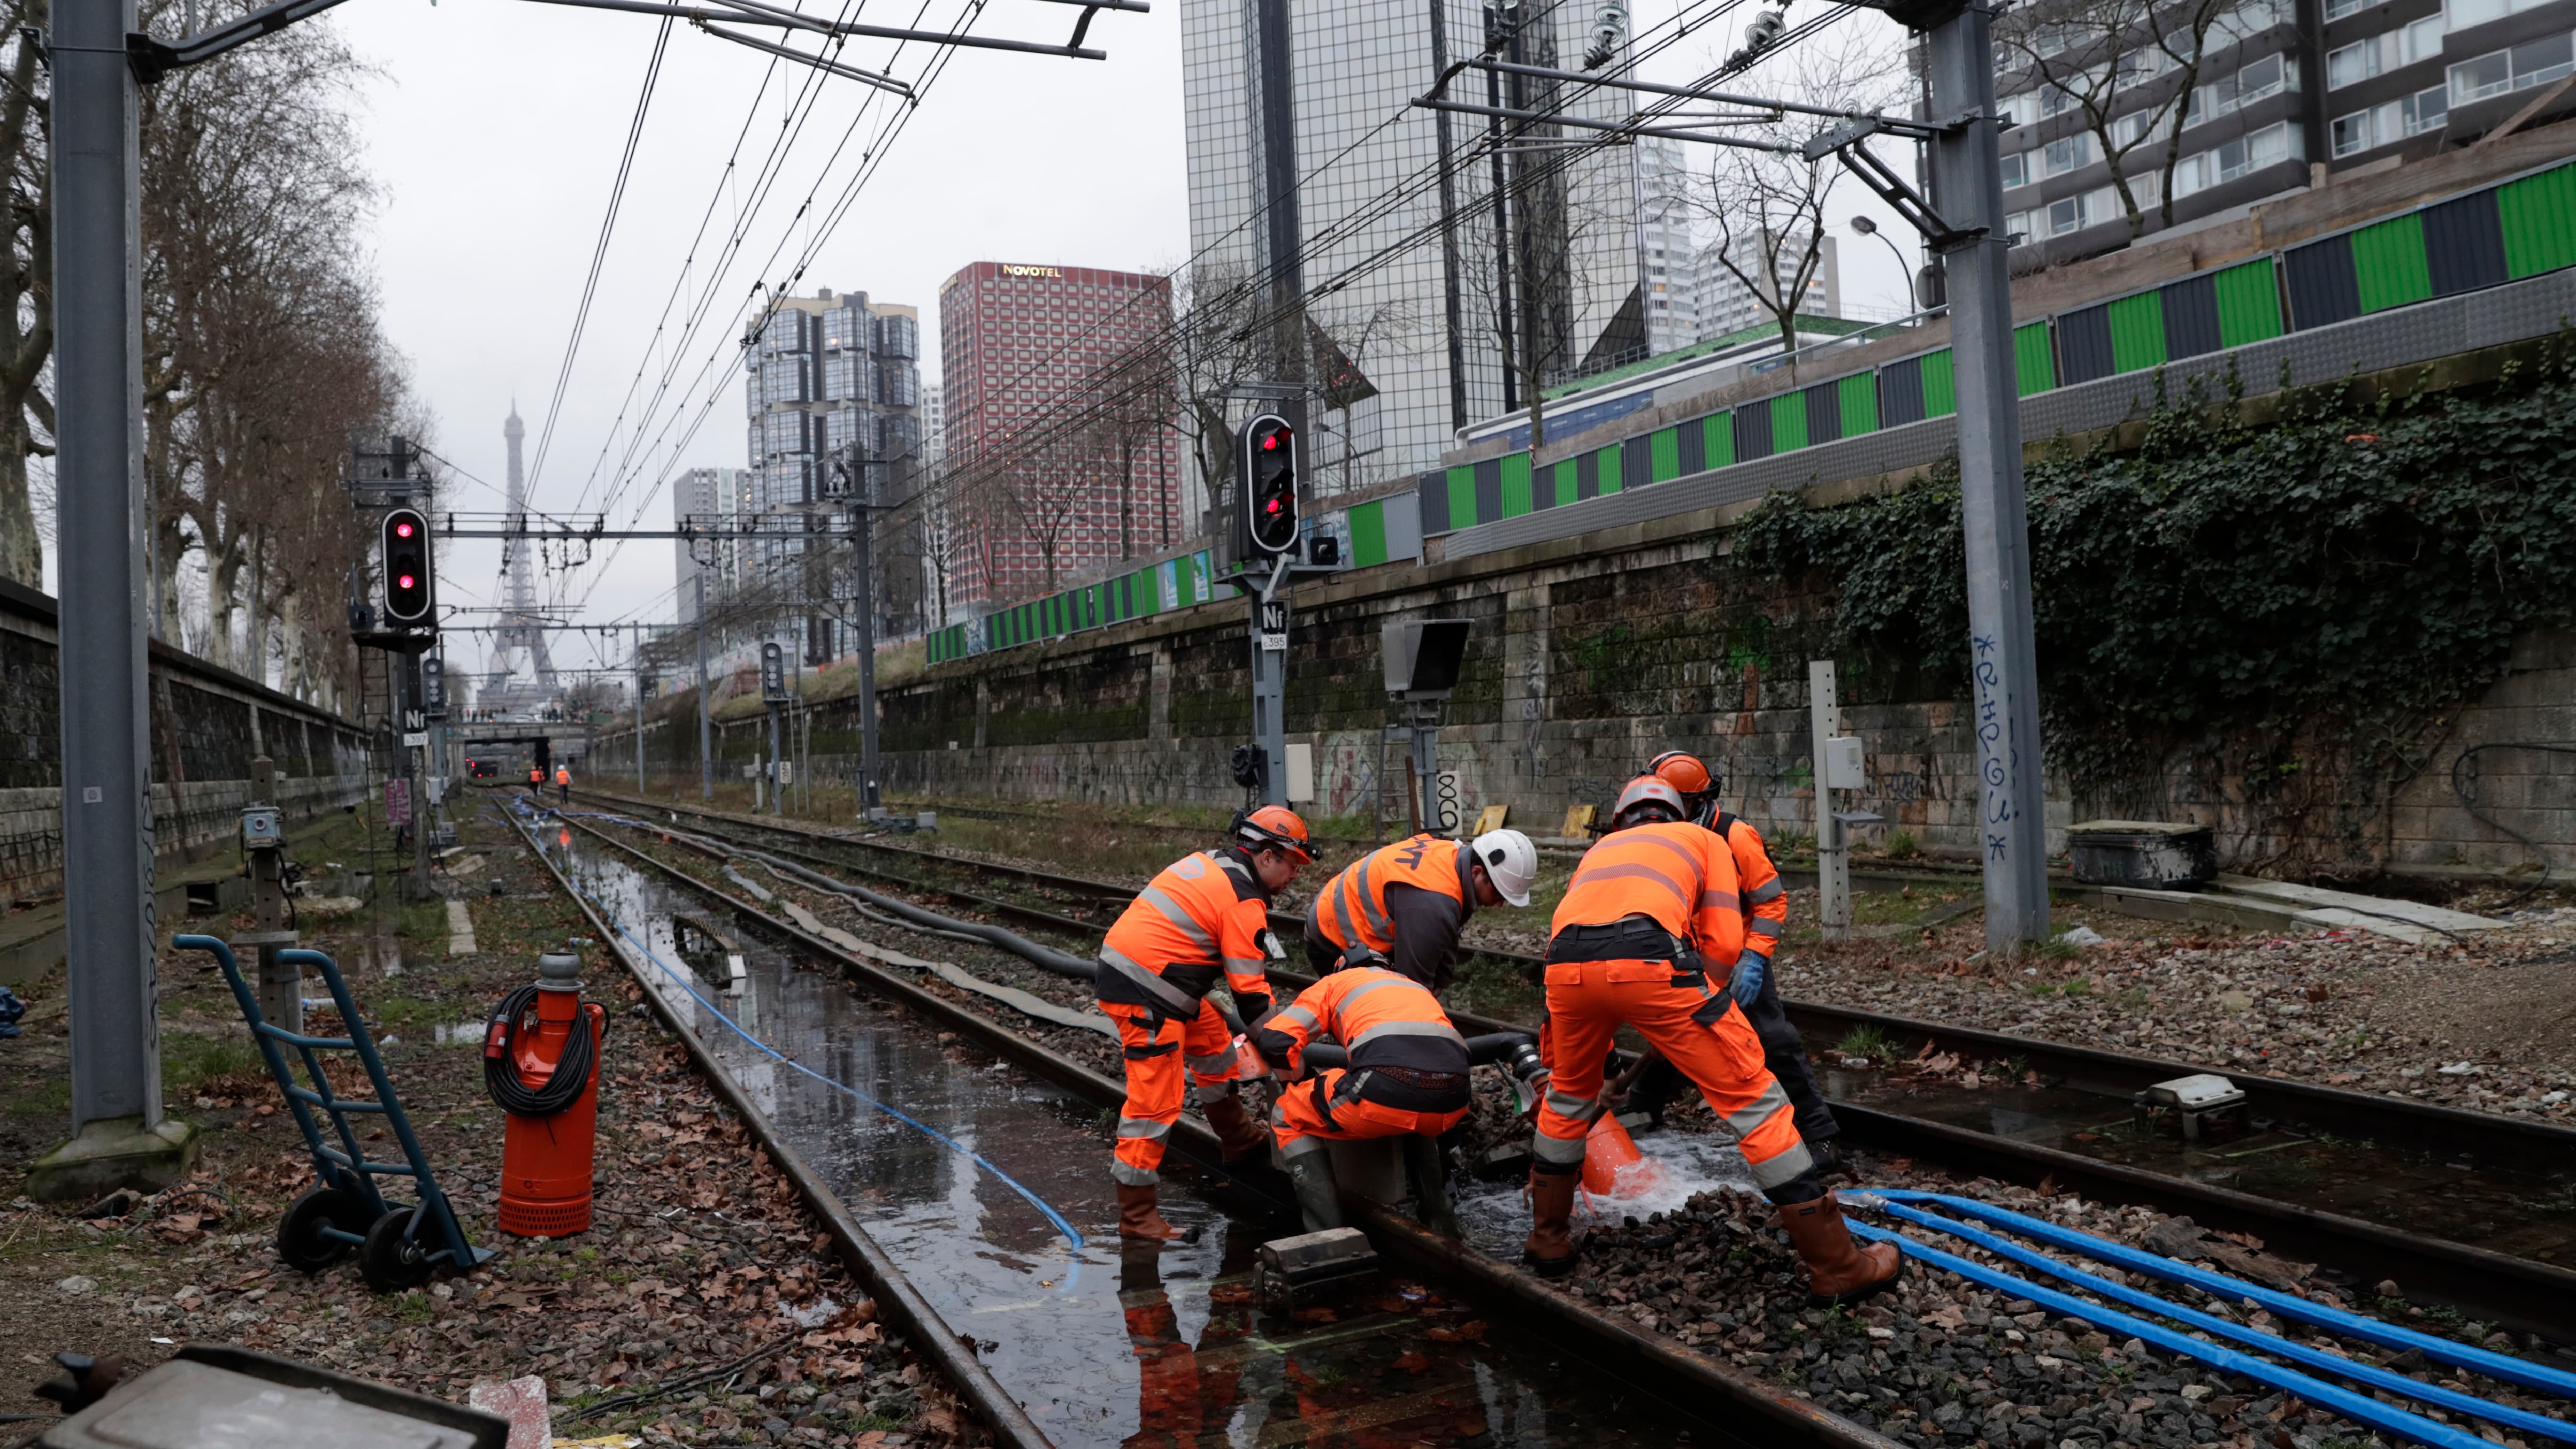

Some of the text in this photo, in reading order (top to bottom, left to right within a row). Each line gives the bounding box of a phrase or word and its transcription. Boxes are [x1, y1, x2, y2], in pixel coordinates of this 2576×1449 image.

[1003, 264, 1062, 277] NOVOTEL
[1263, 605, 1283, 628] Nf
[405, 709, 426, 729] Nf
